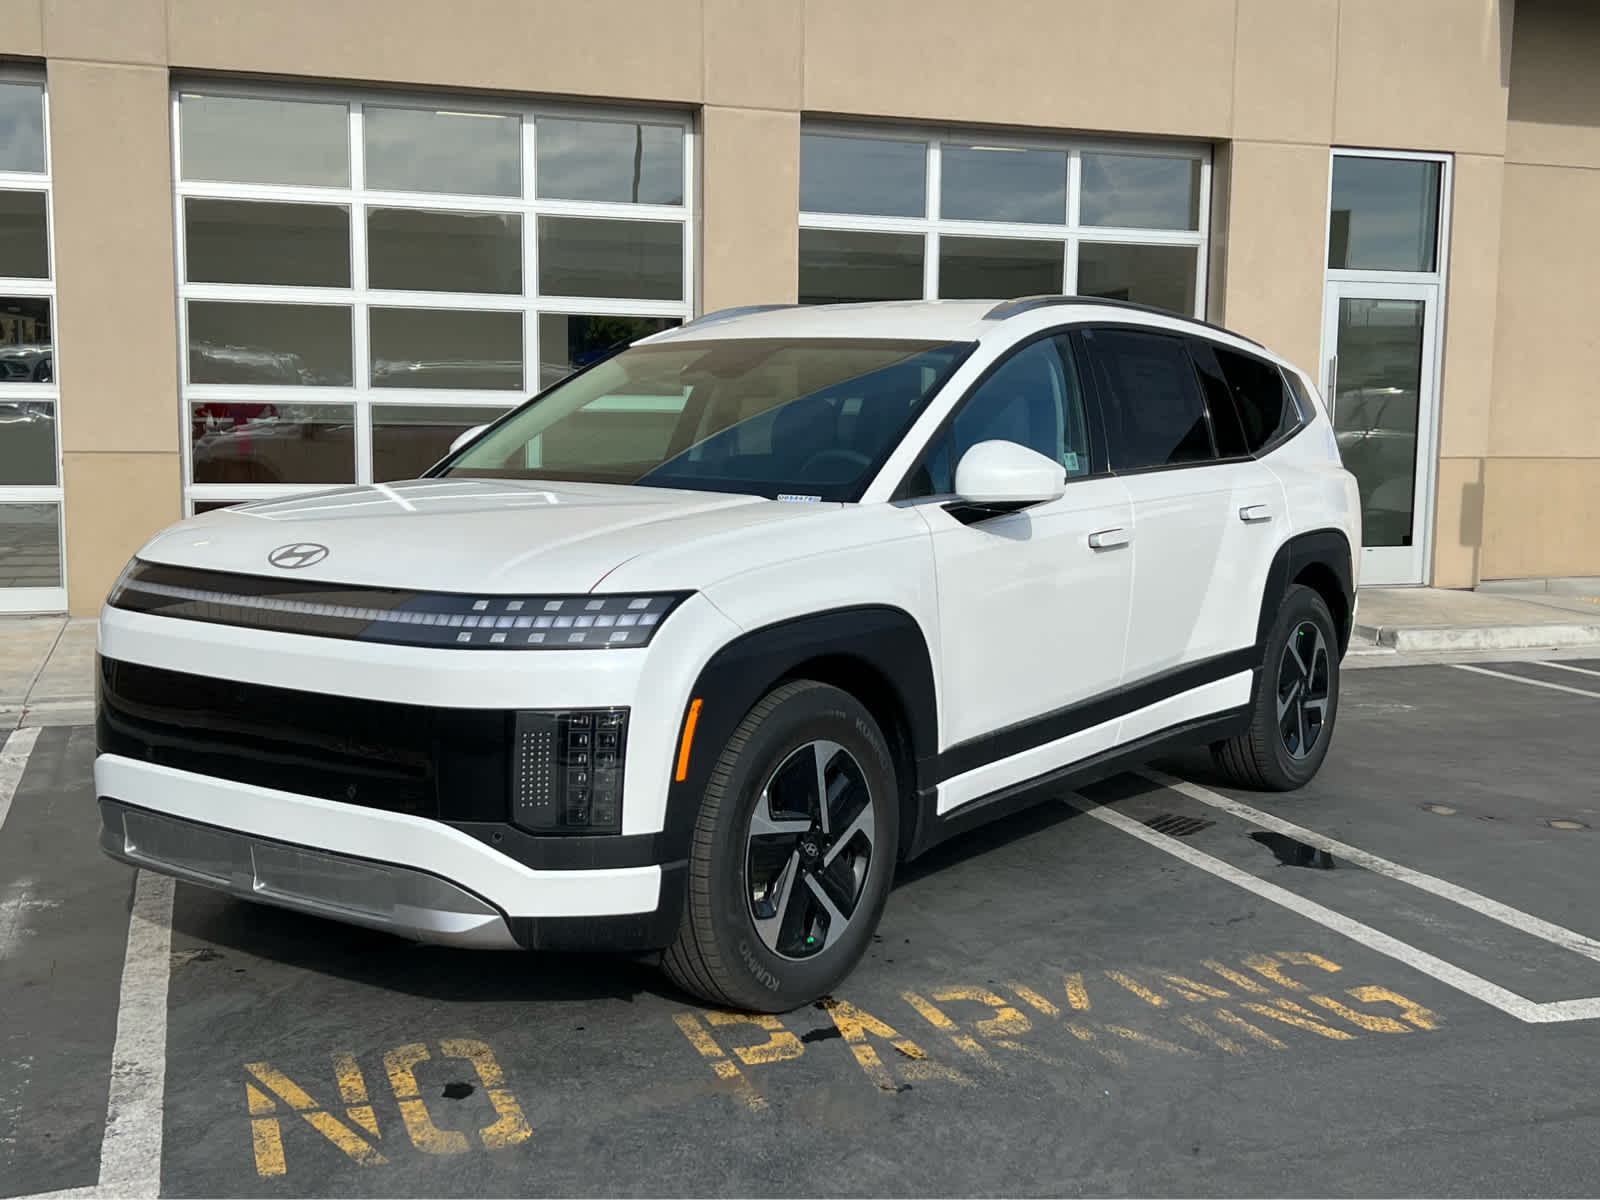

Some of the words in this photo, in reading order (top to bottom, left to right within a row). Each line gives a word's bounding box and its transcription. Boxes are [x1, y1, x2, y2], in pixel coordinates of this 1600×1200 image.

[739, 941, 781, 992] KUMHO
[244, 1039, 533, 1176] NO
[671, 951, 1446, 1111] PARKING
